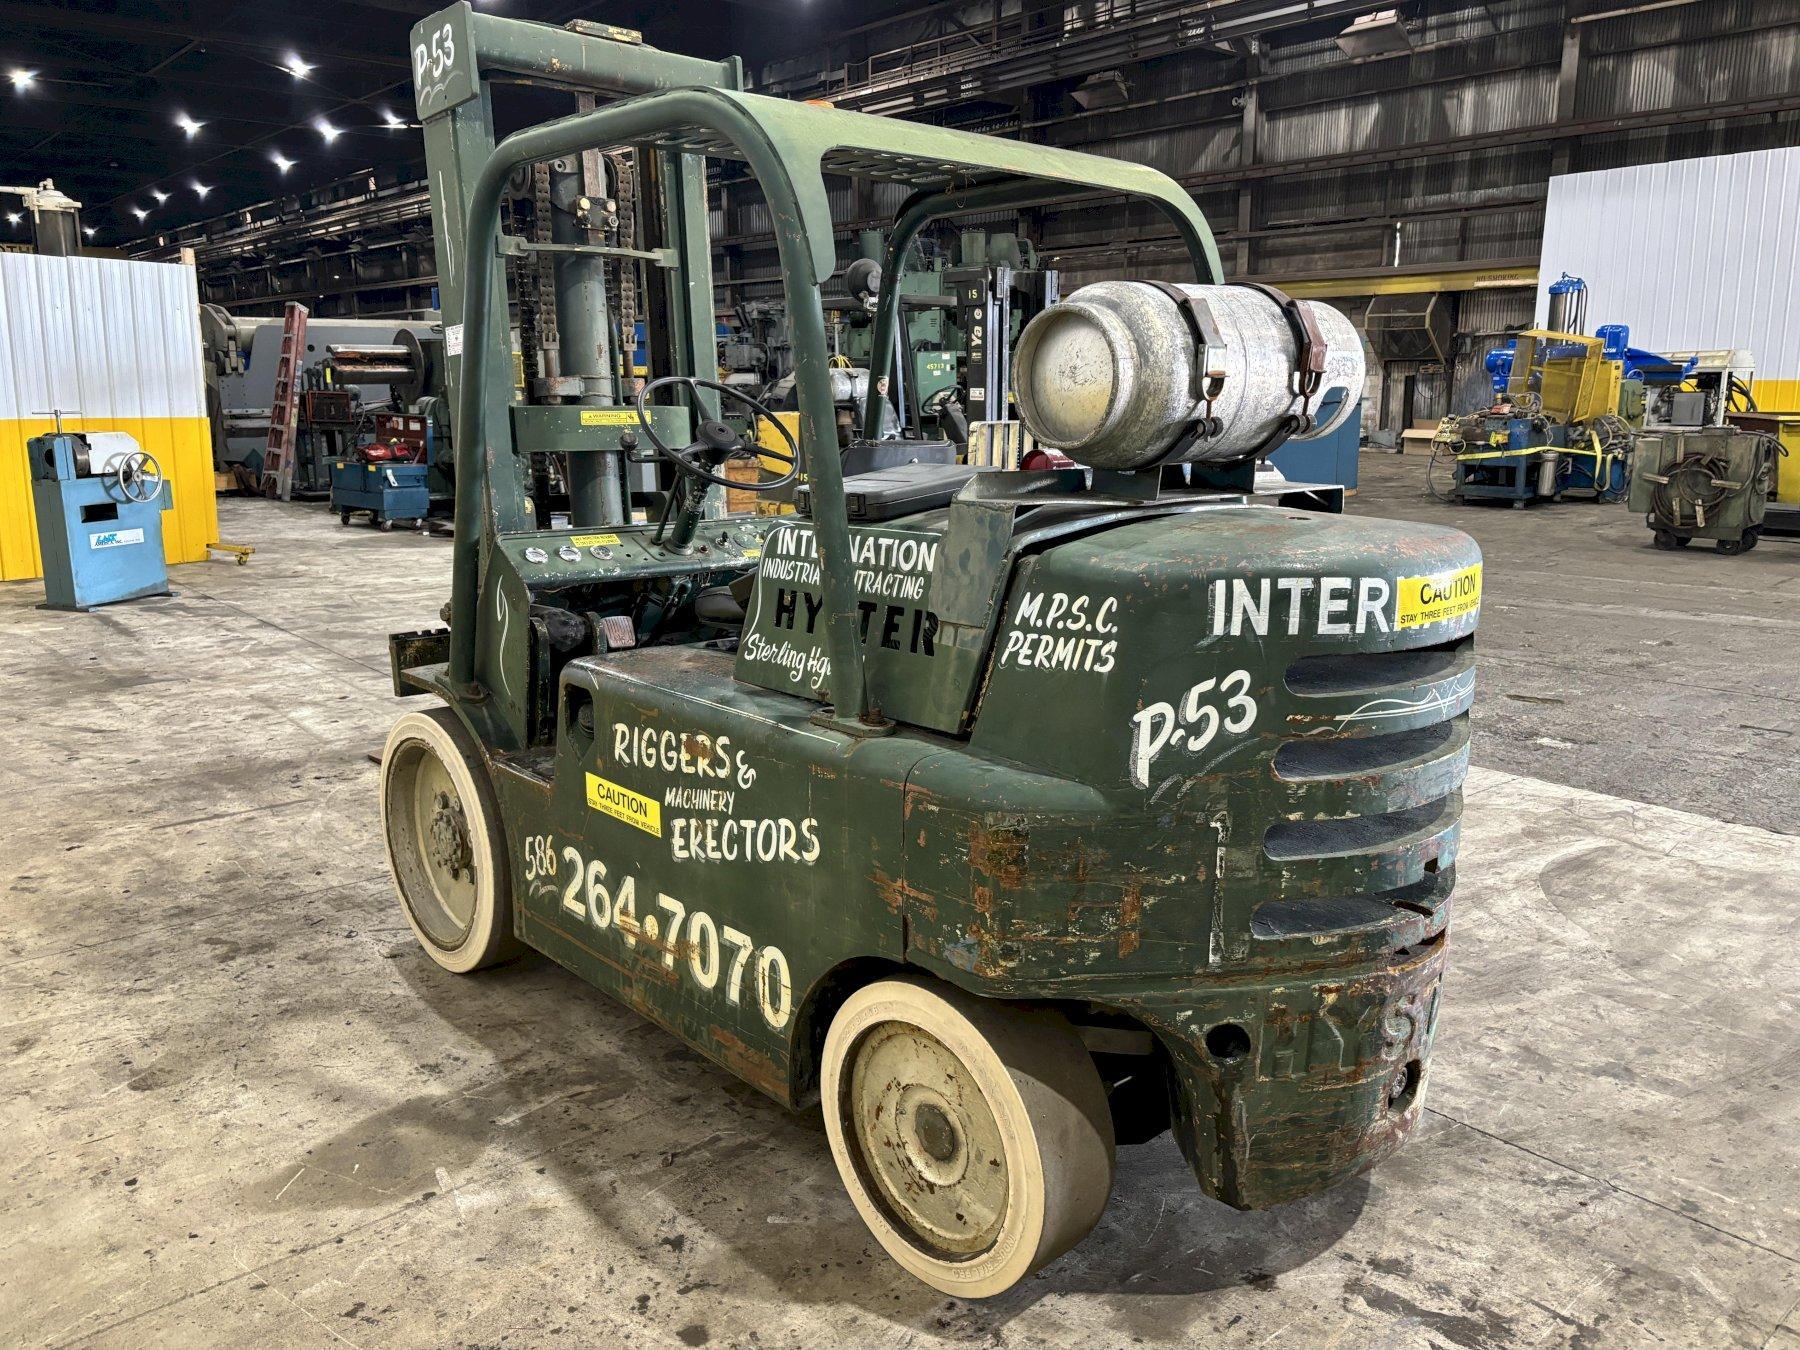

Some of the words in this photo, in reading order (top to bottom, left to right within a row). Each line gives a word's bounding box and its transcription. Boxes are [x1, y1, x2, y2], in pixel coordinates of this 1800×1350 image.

[971, 308, 983, 347] Yae
[762, 558, 822, 586] INDUSTRIA
[1420, 573, 1476, 605] CAUTION
[774, 588, 939, 657] HYTER
[1014, 591, 1118, 634] M.P.S.C.
[1401, 613, 1418, 624] STAY
[1421, 608, 1441, 620] THREE
[1443, 606, 1456, 616] FEET
[744, 633, 806, 682] Sterling
[1000, 630, 1118, 673] PERMITS
[613, 722, 731, 780] RIGGERS
[588, 797, 598, 807] STAY
[599, 802, 613, 814] THREE
[613, 809, 625, 819] FEET
[626, 814, 640, 826] FROM
[640, 821, 660, 835] VEHICLE
[597, 783, 648, 818] CAUTION
[664, 785, 736, 816] MACHINERY
[524, 834, 557, 881] 586
[669, 815, 822, 866] ERECTORS
